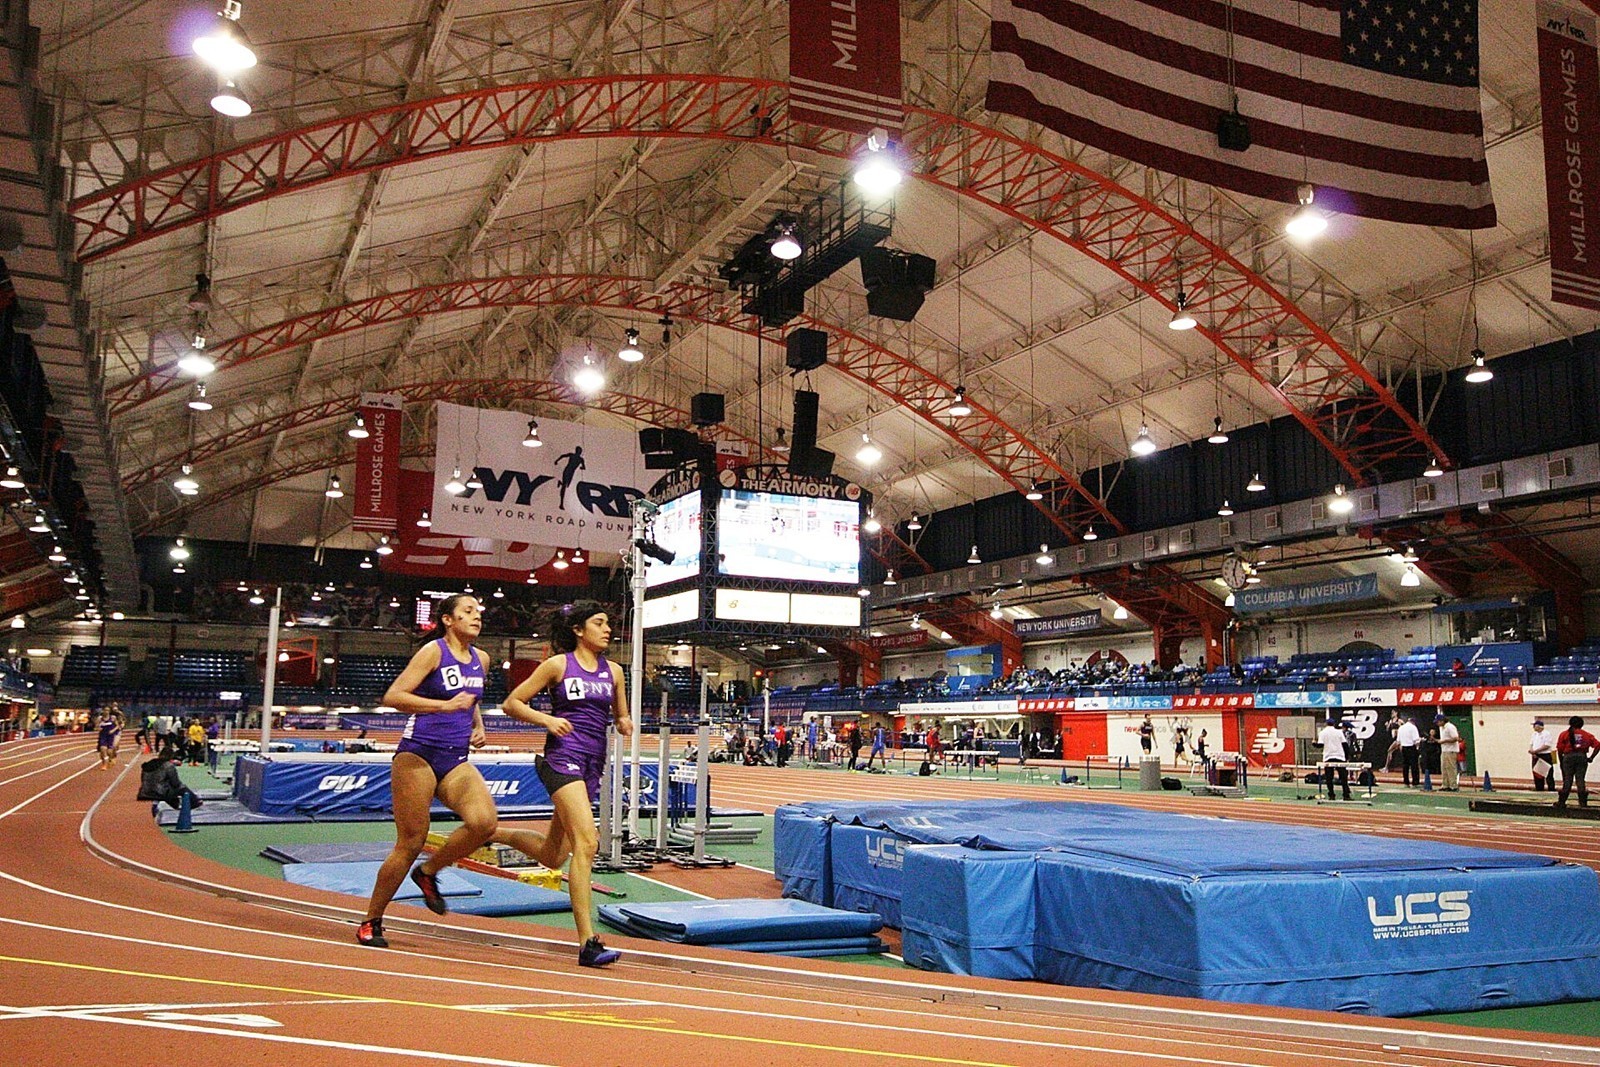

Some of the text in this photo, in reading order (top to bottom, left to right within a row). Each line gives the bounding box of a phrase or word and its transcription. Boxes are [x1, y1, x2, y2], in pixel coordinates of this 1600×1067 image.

[1561, 48, 1587, 263] MILLROSE GAMES
[370, 411, 386, 513] MILLROSE GAMES
[741, 479, 840, 498] THE ARMORY
[451, 503, 484, 514] NEW
[495, 508, 536, 521] YORK
[546, 515, 586, 528] ROAD
[1244, 580, 1362, 604] COLUMBIA UNIVERSITY
[1017, 614, 1097, 632] NEW YORK UNIVERSITY
[446, 667, 459, 687] 6
[569, 679, 581, 697] 4
[1524, 686, 1595, 695] COOGANS COOGANS
[318, 775, 369, 790] GILL
[1367, 890, 1471, 926] UCS
